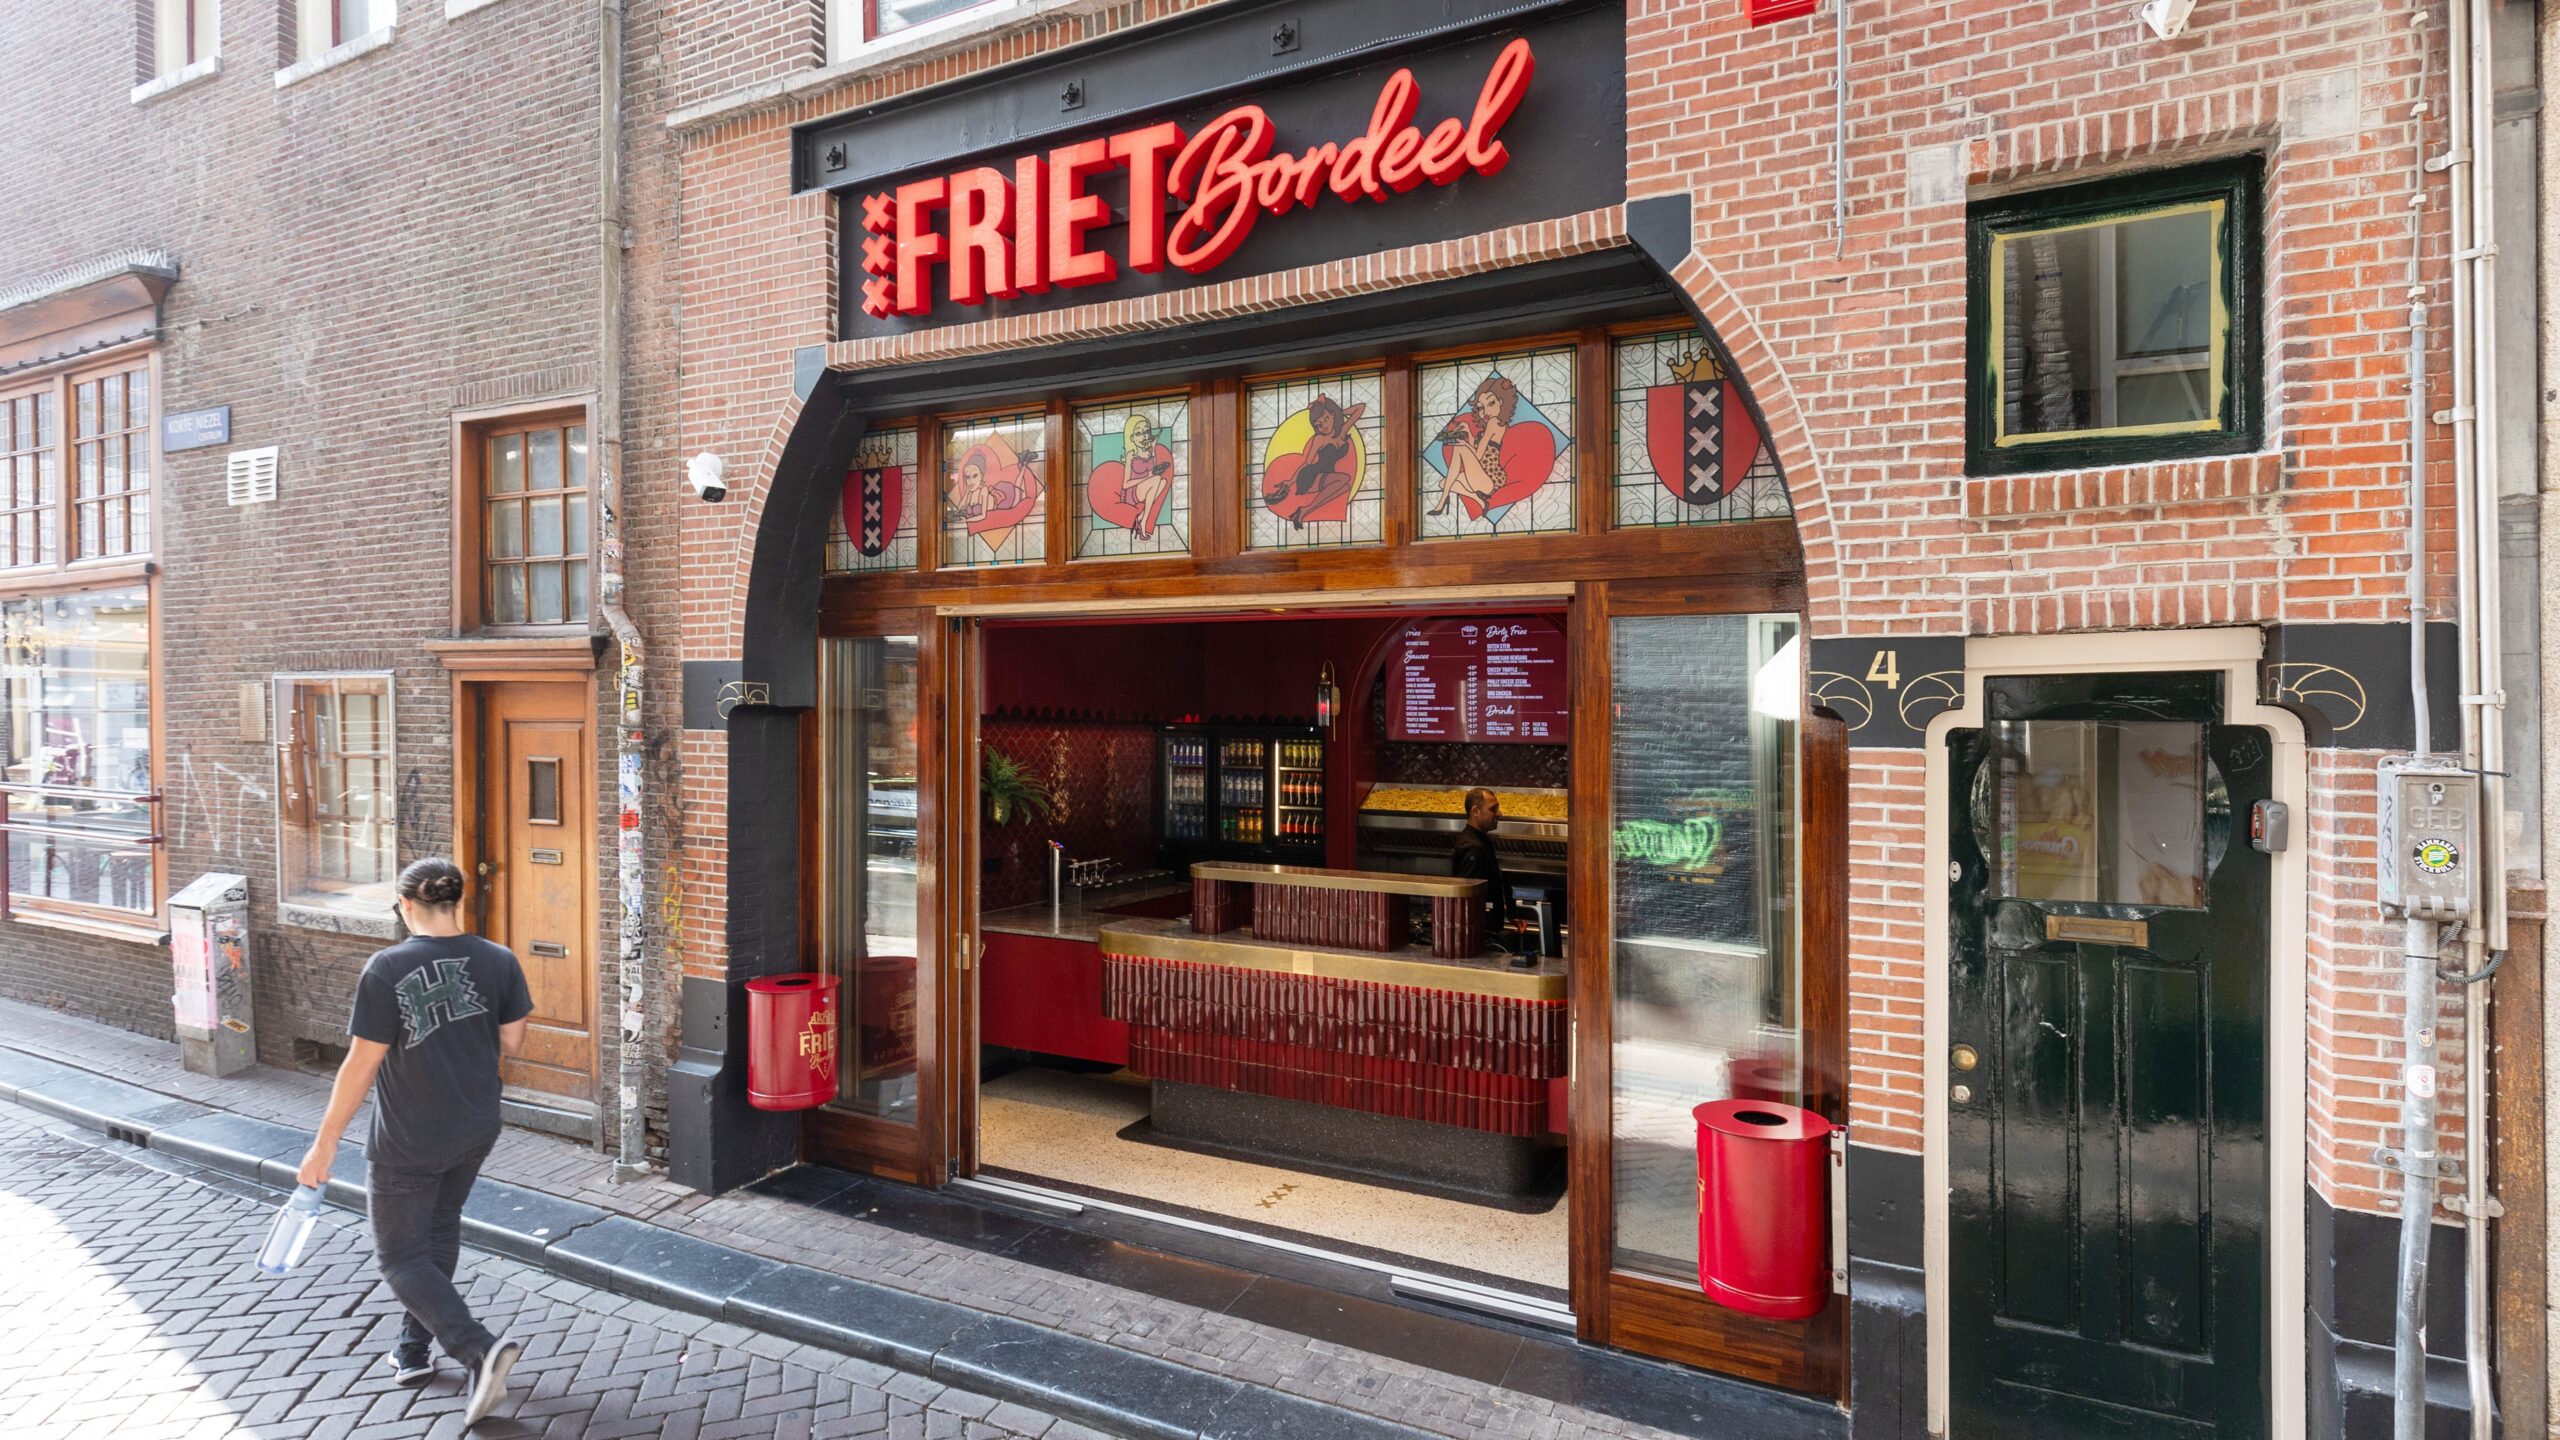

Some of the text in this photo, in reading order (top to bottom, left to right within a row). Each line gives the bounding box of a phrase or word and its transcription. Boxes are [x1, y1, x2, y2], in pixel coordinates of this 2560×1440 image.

[895, 37, 1537, 318] FRIET Bordeel
[168, 412, 223, 434] KORTE NIEZEL
[1486, 624, 1528, 642] Dirty Fries
[1404, 649, 1430, 664] Sauces
[1866, 650, 1900, 689] 4
[1485, 704, 1516, 718] Drinks
[2410, 806, 2465, 831] GEB
[799, 1028, 837, 1057] FRIE
